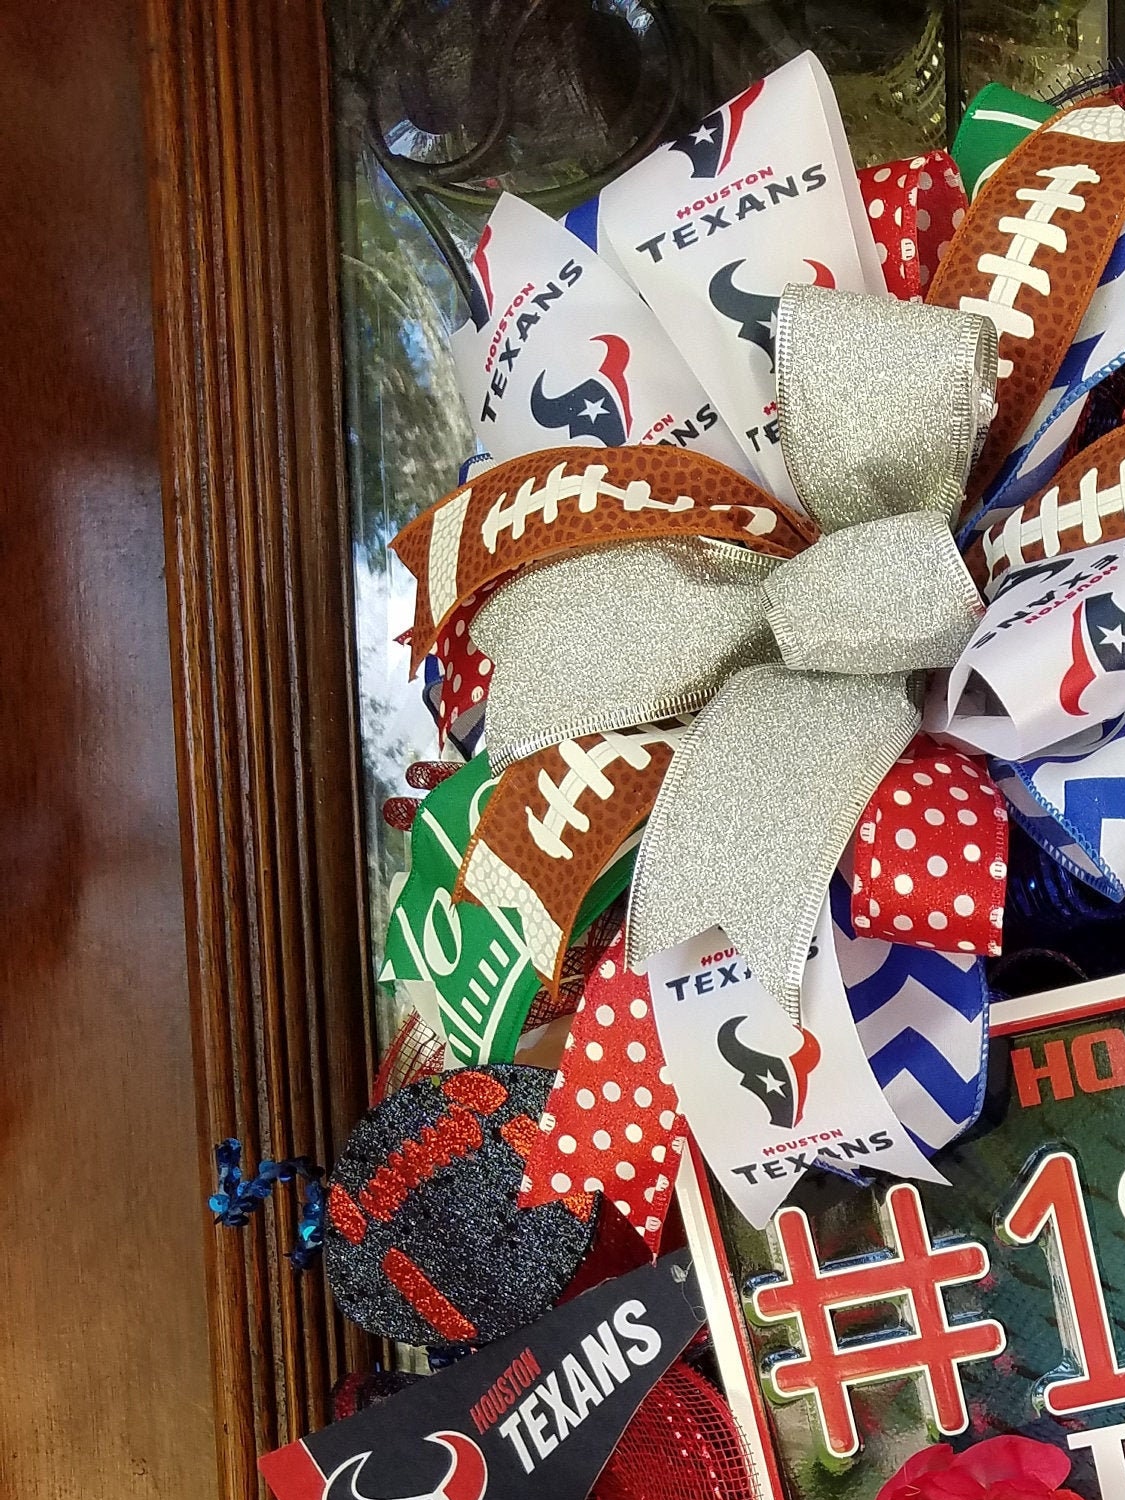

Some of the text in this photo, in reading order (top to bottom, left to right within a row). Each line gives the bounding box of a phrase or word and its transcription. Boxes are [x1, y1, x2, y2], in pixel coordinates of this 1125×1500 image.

[636, 163, 828, 264] TEXANS
[676, 165, 774, 220] HOUSTON
[480, 258, 583, 423] TEXANS
[484, 282, 536, 373] HOUSTON
[1025, 565, 1118, 624] HOUSTON
[762, 1128, 844, 1157] HOUSTON
[469, 1348, 541, 1435] HOUSTON
[499, 1299, 662, 1475] TEXANS
